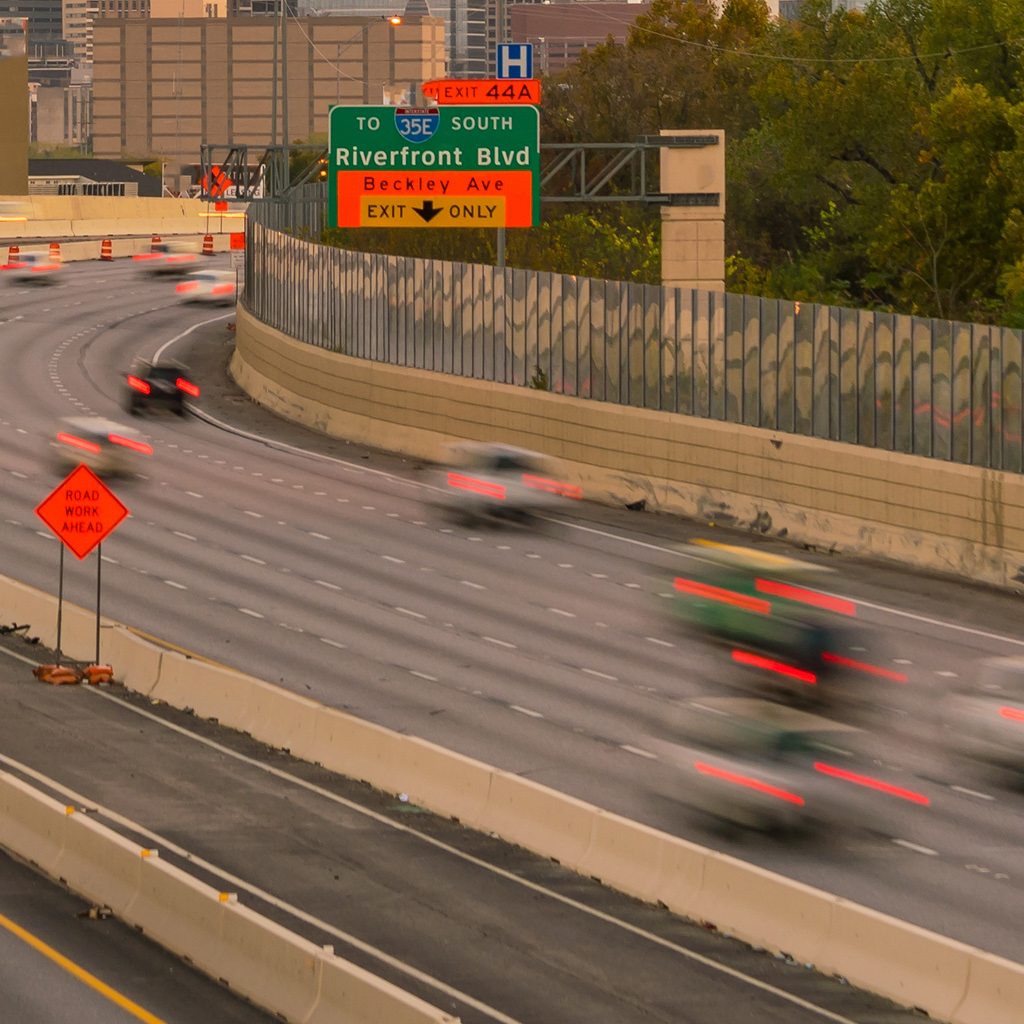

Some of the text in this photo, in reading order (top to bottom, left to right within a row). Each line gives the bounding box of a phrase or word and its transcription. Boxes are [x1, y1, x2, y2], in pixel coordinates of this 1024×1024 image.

[502, 45, 527, 78] H
[445, 86, 478, 98] EXIT
[486, 84, 532, 100] 44A
[356, 116, 513, 136] TO 35E SOUTH
[336, 146, 530, 166] Riverfront Blvd
[364, 176, 504, 194] Beckley Ave
[367, 204, 497, 218] EXIT ONLY
[65, 490, 100, 501] ROAD
[65, 506, 100, 517] WORK
[61, 522, 103, 533] AHEAD
